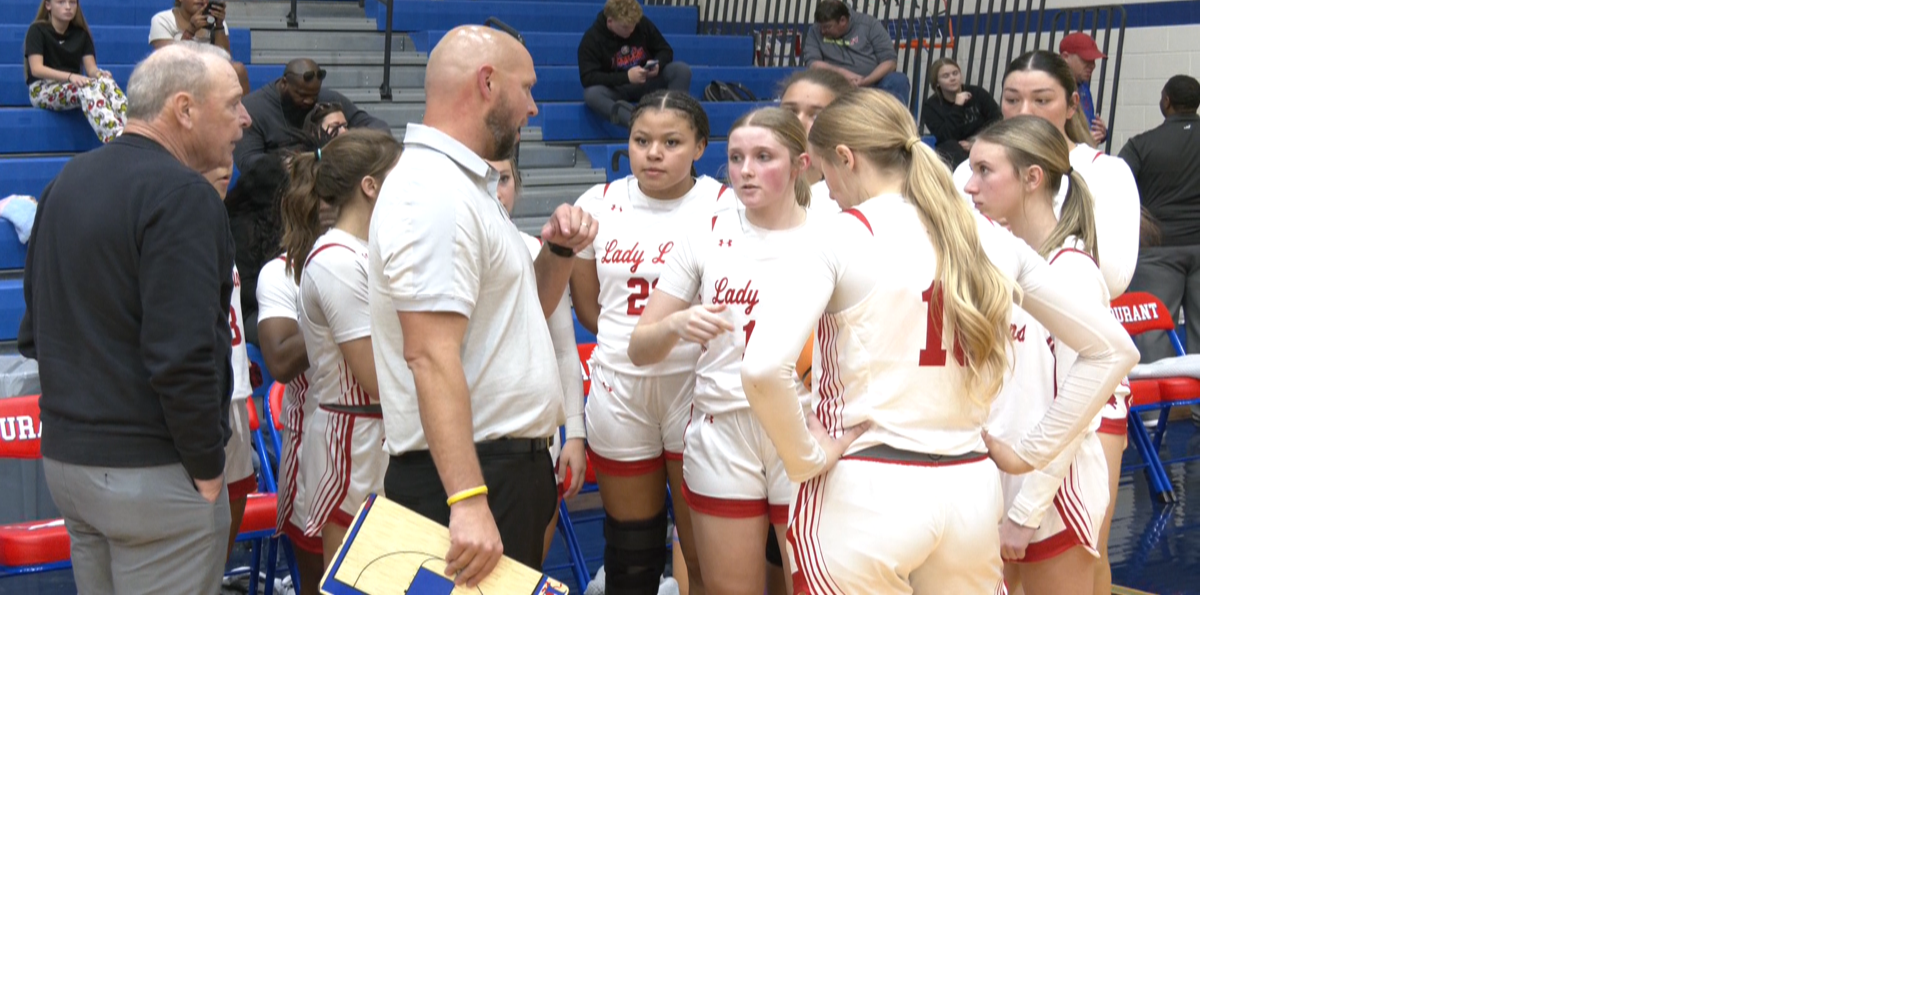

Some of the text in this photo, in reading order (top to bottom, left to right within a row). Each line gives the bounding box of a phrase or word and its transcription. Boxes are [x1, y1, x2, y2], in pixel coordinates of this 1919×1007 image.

[601, 239, 645, 273] Lady
[627, 277, 659, 315] 2
[712, 276, 759, 315] Lady
[0, 415, 43, 441] UR
